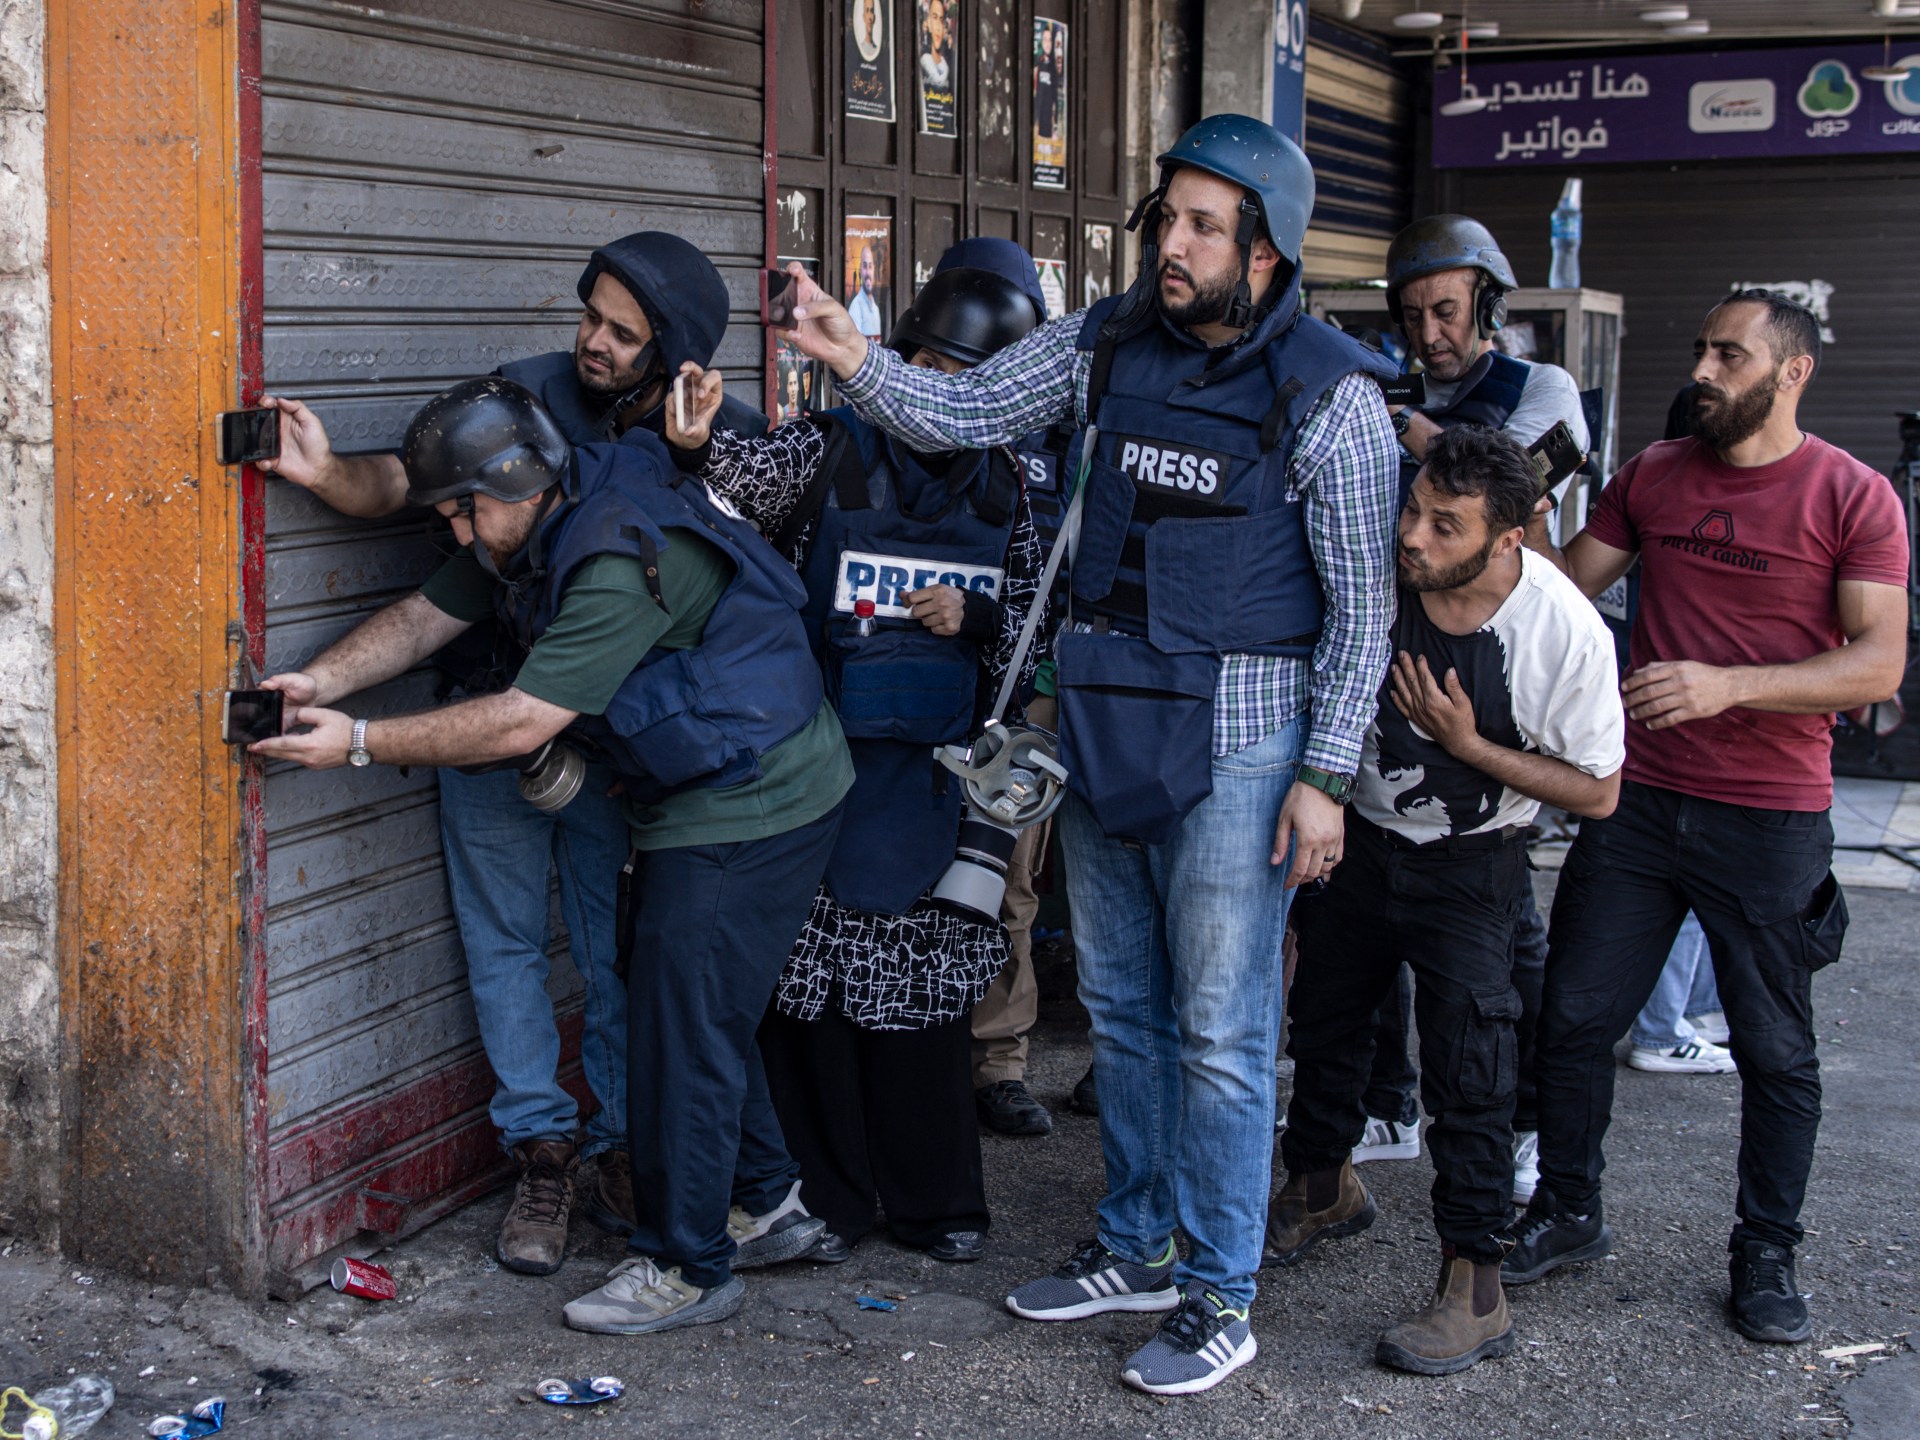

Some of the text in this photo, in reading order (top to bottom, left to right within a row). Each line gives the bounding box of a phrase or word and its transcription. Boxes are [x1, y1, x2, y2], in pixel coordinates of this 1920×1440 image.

[1592, 65, 1650, 99] هنا
[1495, 115, 1609, 160] فواتير
[1120, 441, 1219, 494] PRESS
[1660, 536, 1769, 573] pierre cardin
[1206, 1292, 1223, 1309] adidas
